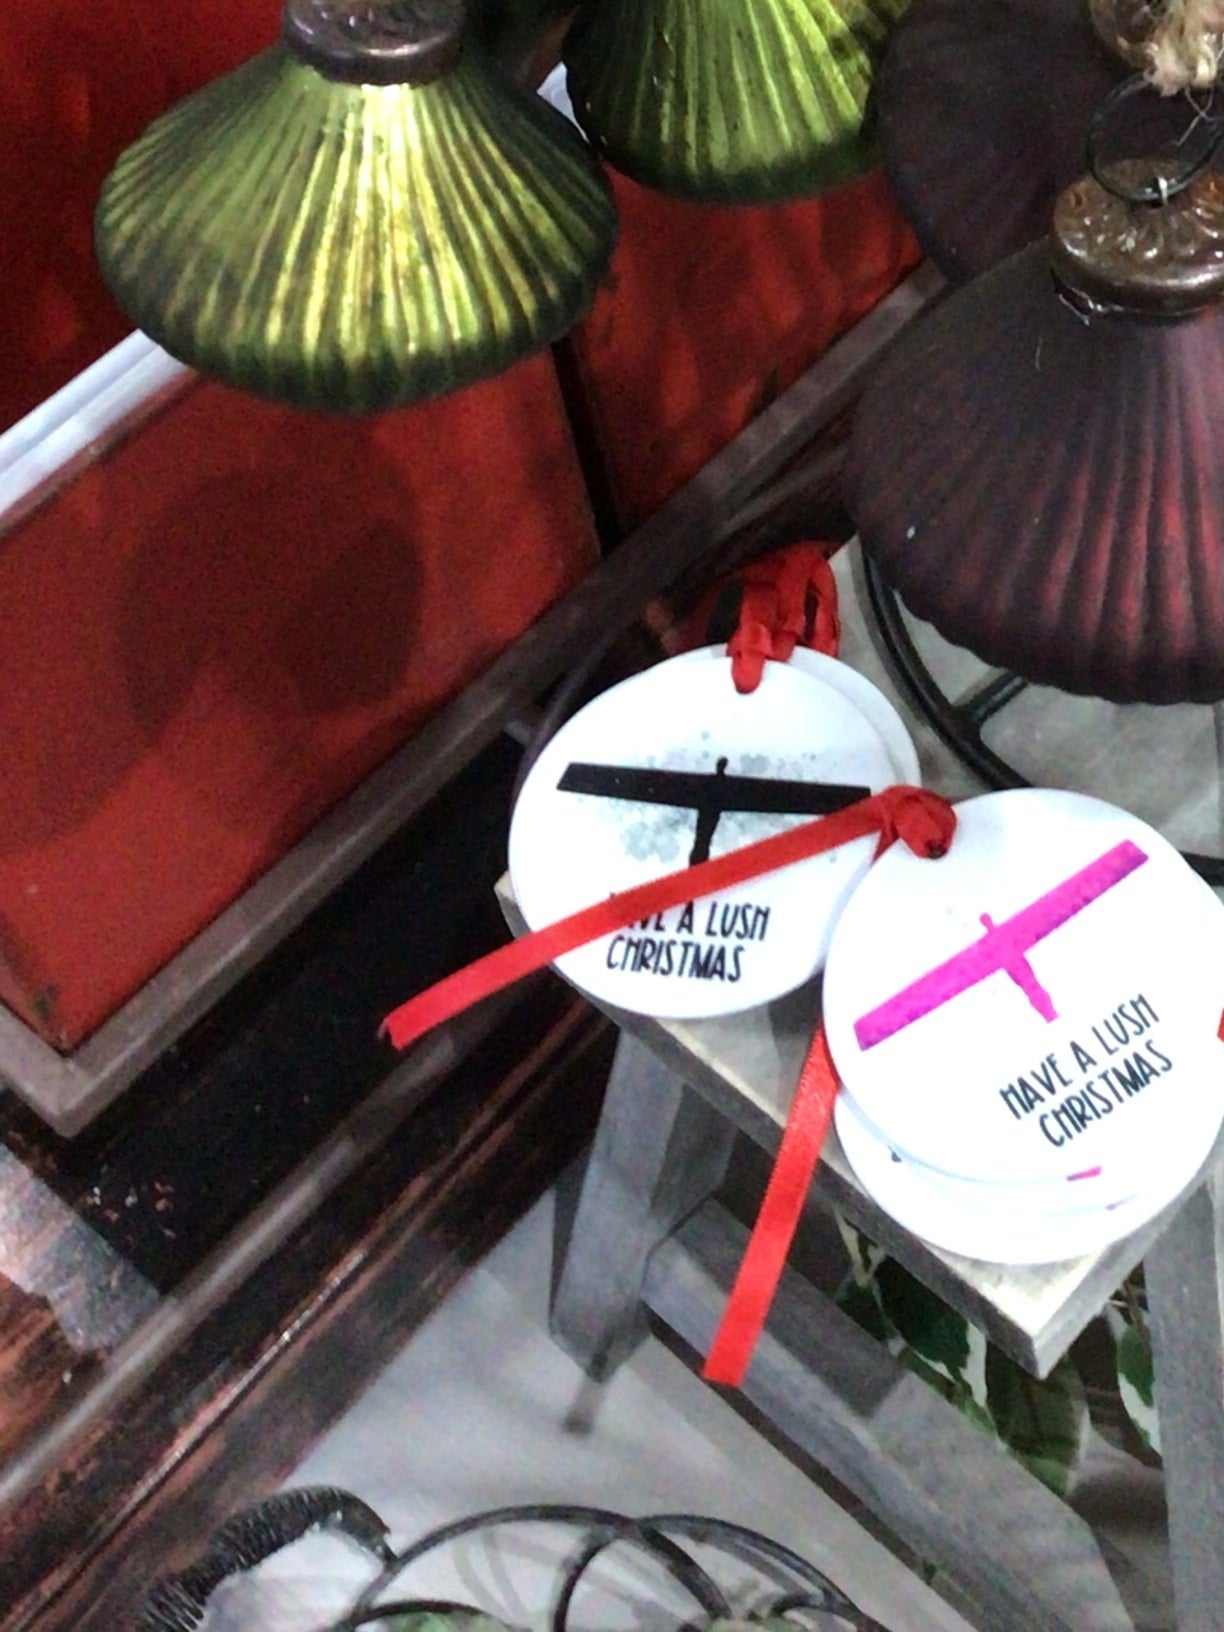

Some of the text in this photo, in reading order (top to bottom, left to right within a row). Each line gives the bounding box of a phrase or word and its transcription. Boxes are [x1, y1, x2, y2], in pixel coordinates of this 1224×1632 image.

[606, 934, 744, 983] CHRISTMAS
[675, 899, 695, 934] A
[705, 901, 771, 941] LUSH
[999, 993, 1160, 1120] HAVE A LUSH
[1039, 1039, 1172, 1147] CHRISTMAS
